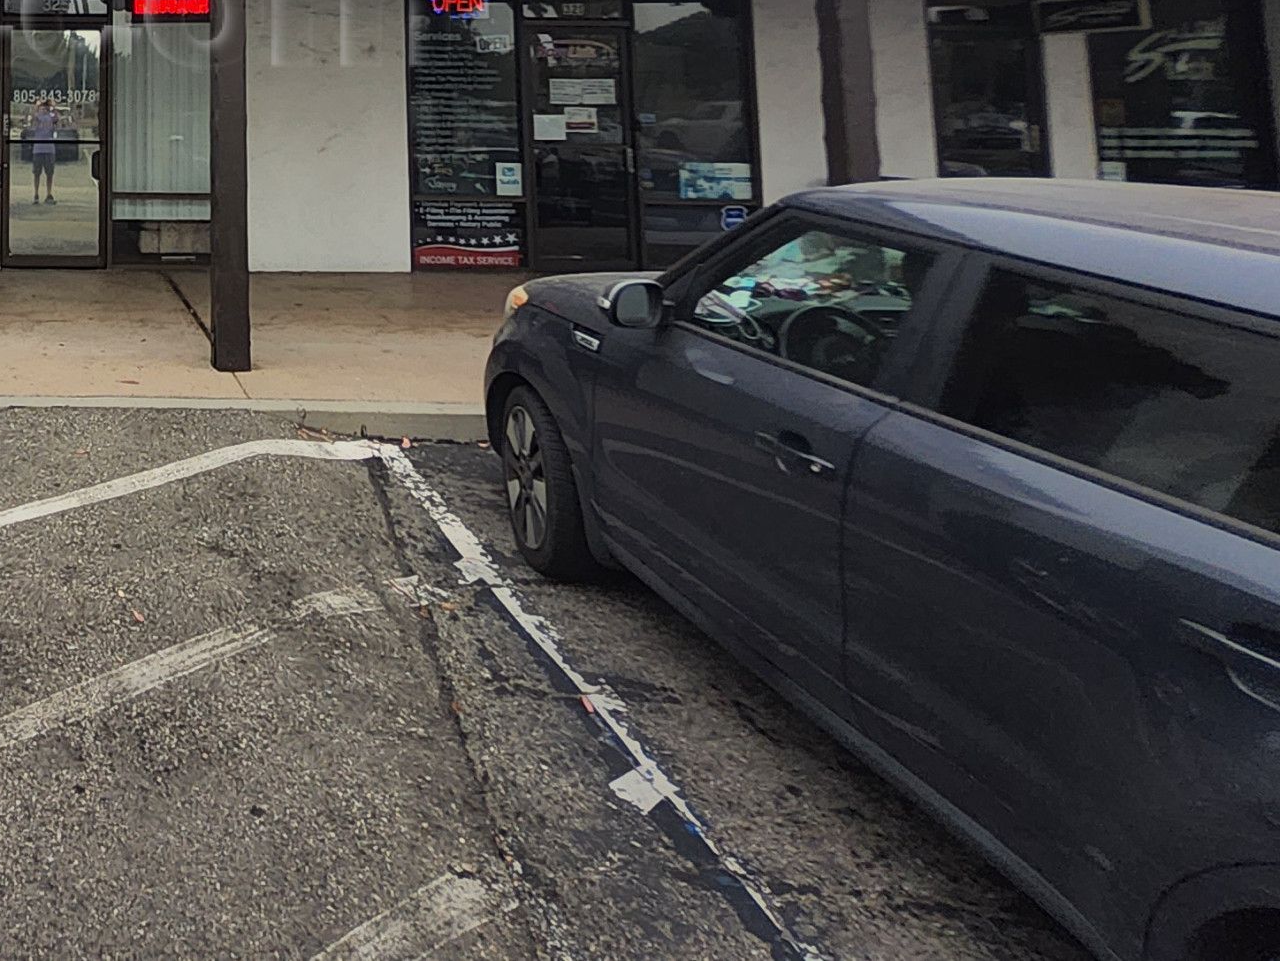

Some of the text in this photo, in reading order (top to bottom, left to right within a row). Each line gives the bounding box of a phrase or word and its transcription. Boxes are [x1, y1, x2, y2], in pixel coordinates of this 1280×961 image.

[13, 90, 96, 103] 805-843-3078
[419, 256, 456, 266] INCOME
[458, 256, 476, 266] TAX
